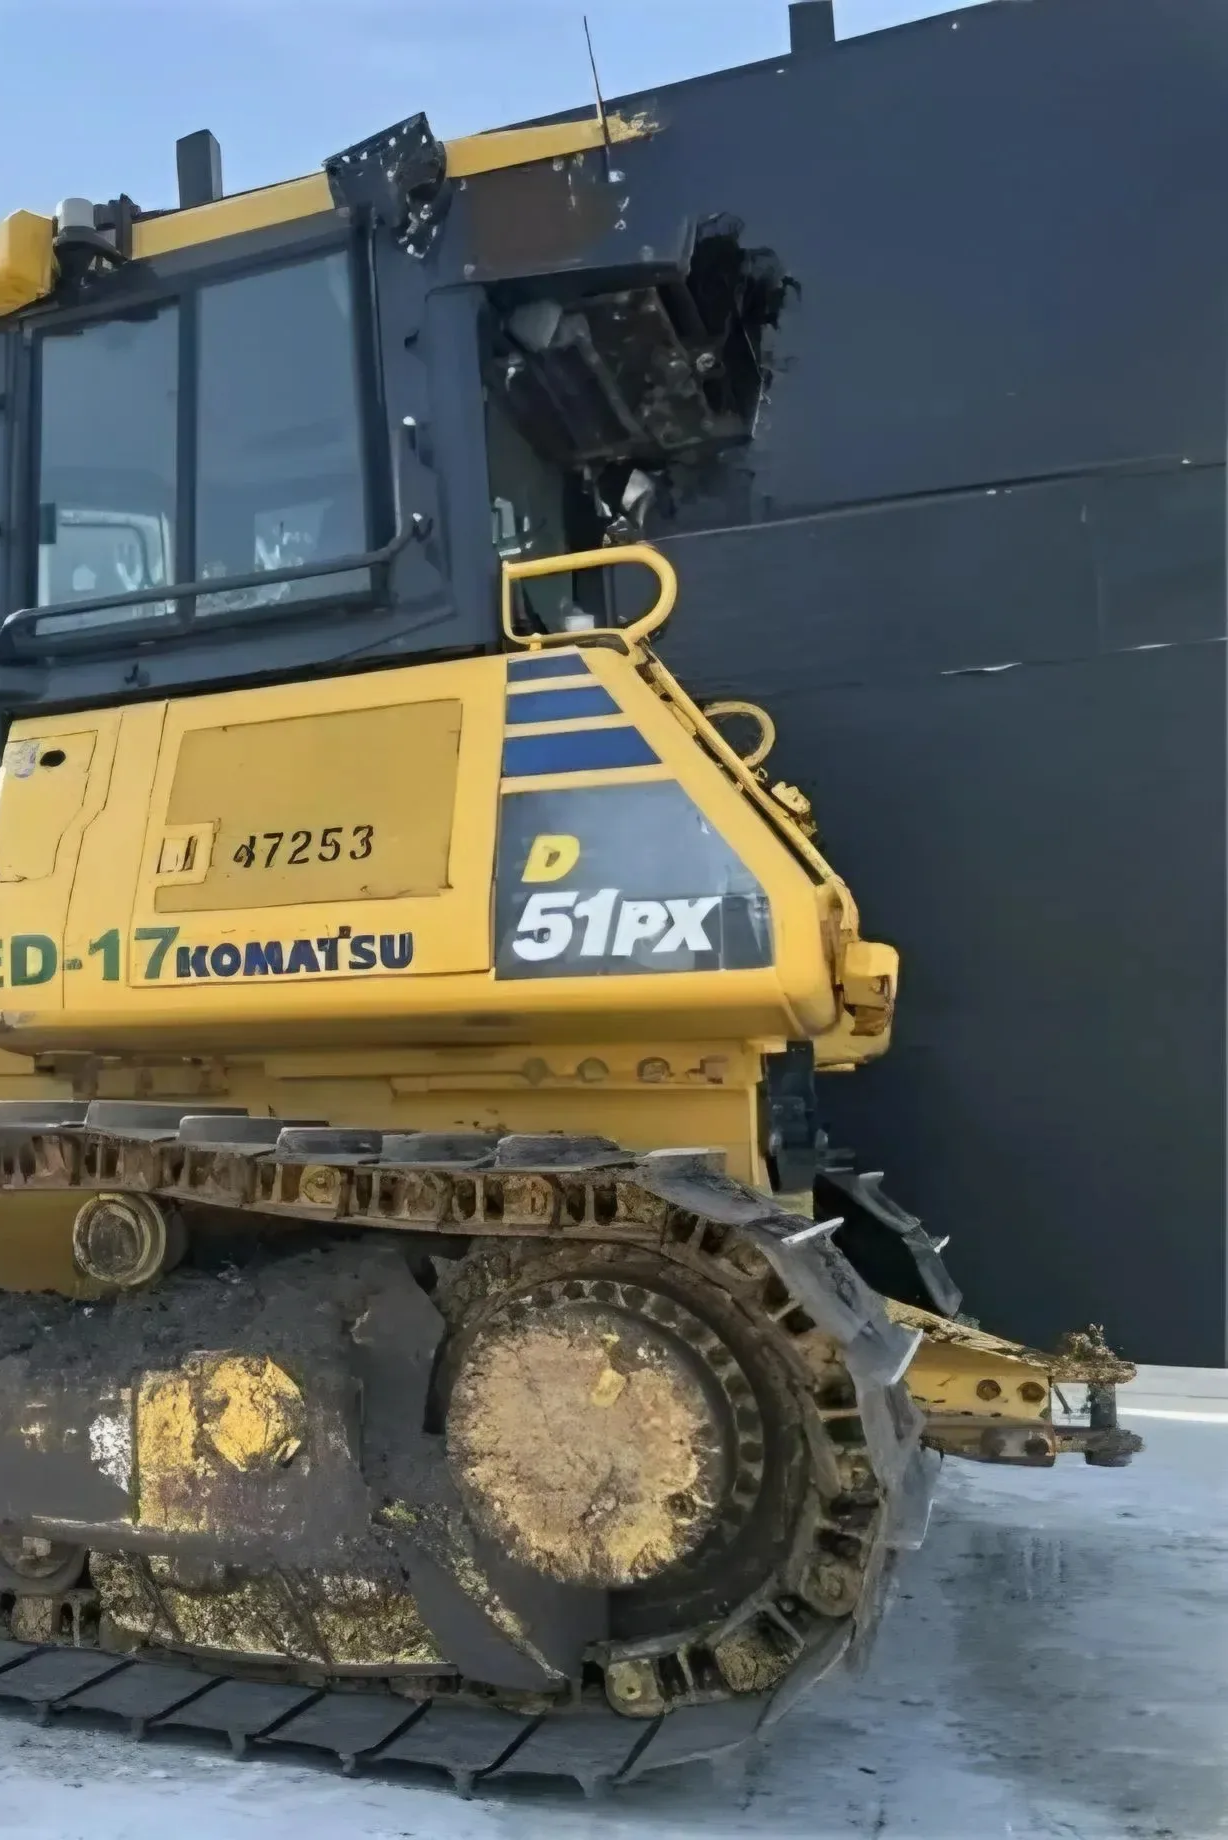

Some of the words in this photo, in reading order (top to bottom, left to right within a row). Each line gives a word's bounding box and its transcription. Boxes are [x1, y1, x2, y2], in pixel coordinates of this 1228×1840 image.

[521, 833, 581, 883] D
[512, 888, 722, 961] 51PX
[176, 931, 414, 979] KOMATSU
